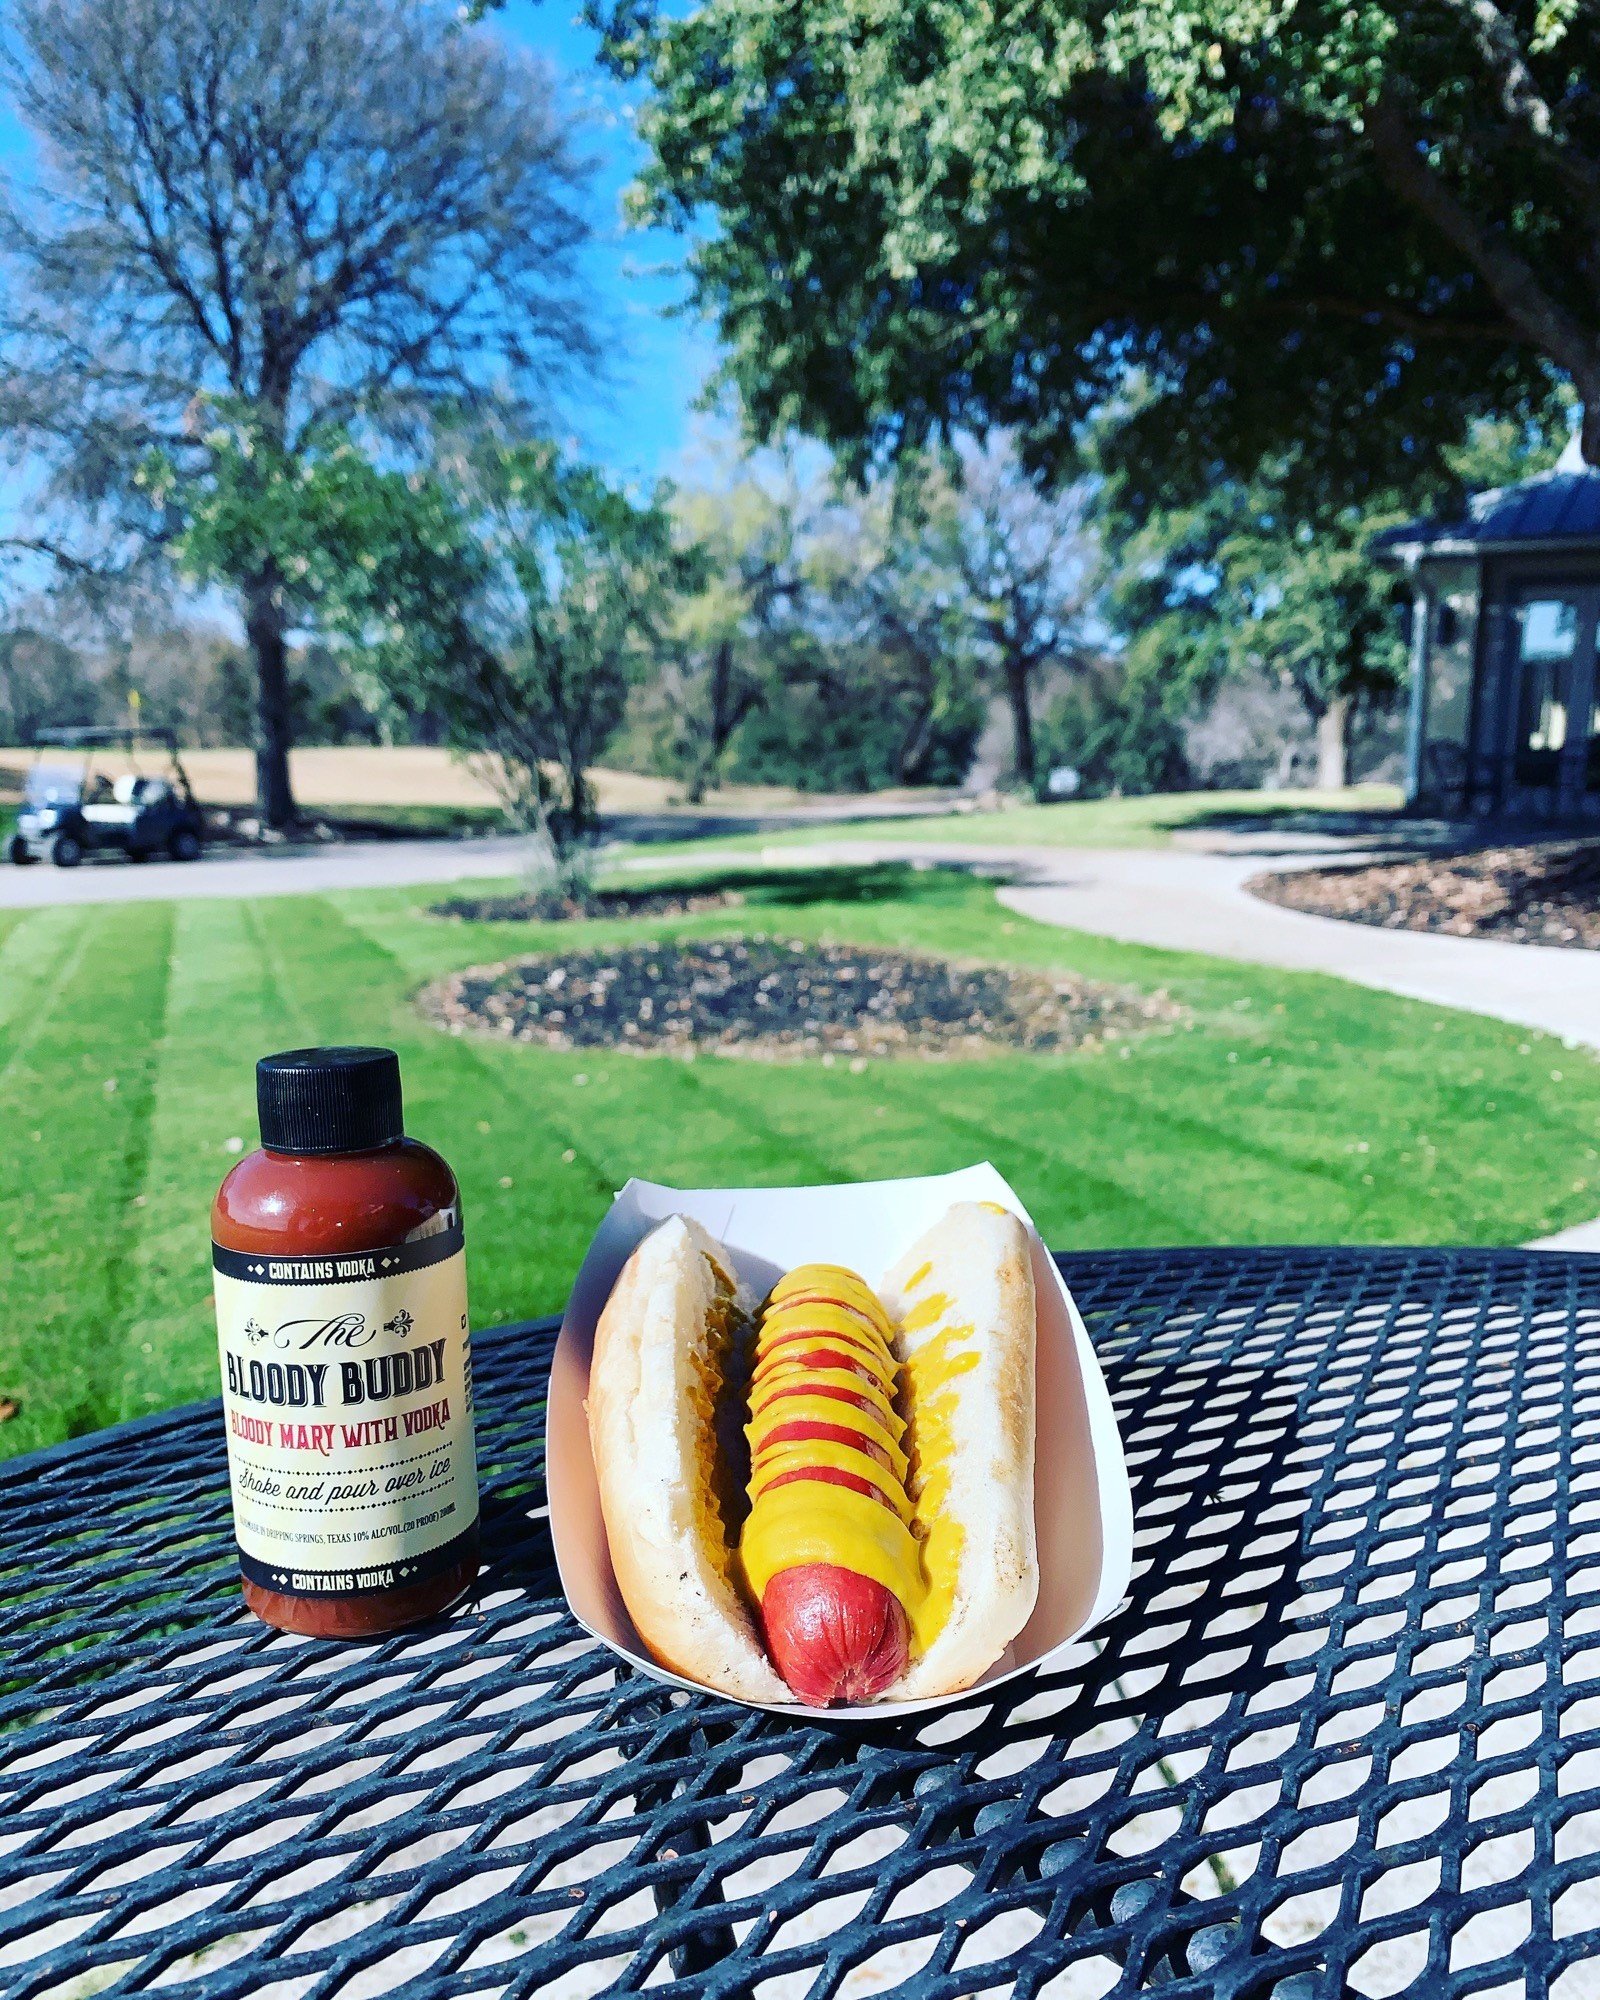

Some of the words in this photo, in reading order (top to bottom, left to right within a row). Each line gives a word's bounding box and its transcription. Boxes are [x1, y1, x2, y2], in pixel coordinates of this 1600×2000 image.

[268, 1262, 333, 1280] CONTAINS
[336, 1258, 376, 1278] VODKA
[273, 1312, 377, 1350] The
[226, 1350, 330, 1408] BLOODY
[338, 1338, 447, 1407] BUDDY
[230, 1409, 274, 1447] BLOODY
[279, 1424, 336, 1457] MARY
[340, 1416, 399, 1447] WITH
[402, 1398, 452, 1438] VODKA
[238, 1467, 282, 1497] Shake
[286, 1481, 324, 1501] and
[324, 1480, 379, 1506] pour
[384, 1467, 426, 1493] over
[429, 1457, 452, 1480] ice
[266, 1527, 294, 1543] DRIPPING
[294, 1532, 326, 1545] SPRINGS,
[327, 1533, 351, 1544] TEXAS
[353, 1530, 370, 1542] 10%
[416, 1510, 440, 1529] PROOF)
[292, 1573, 354, 1592] CONTAINS
[357, 1569, 395, 1589] VODKA
